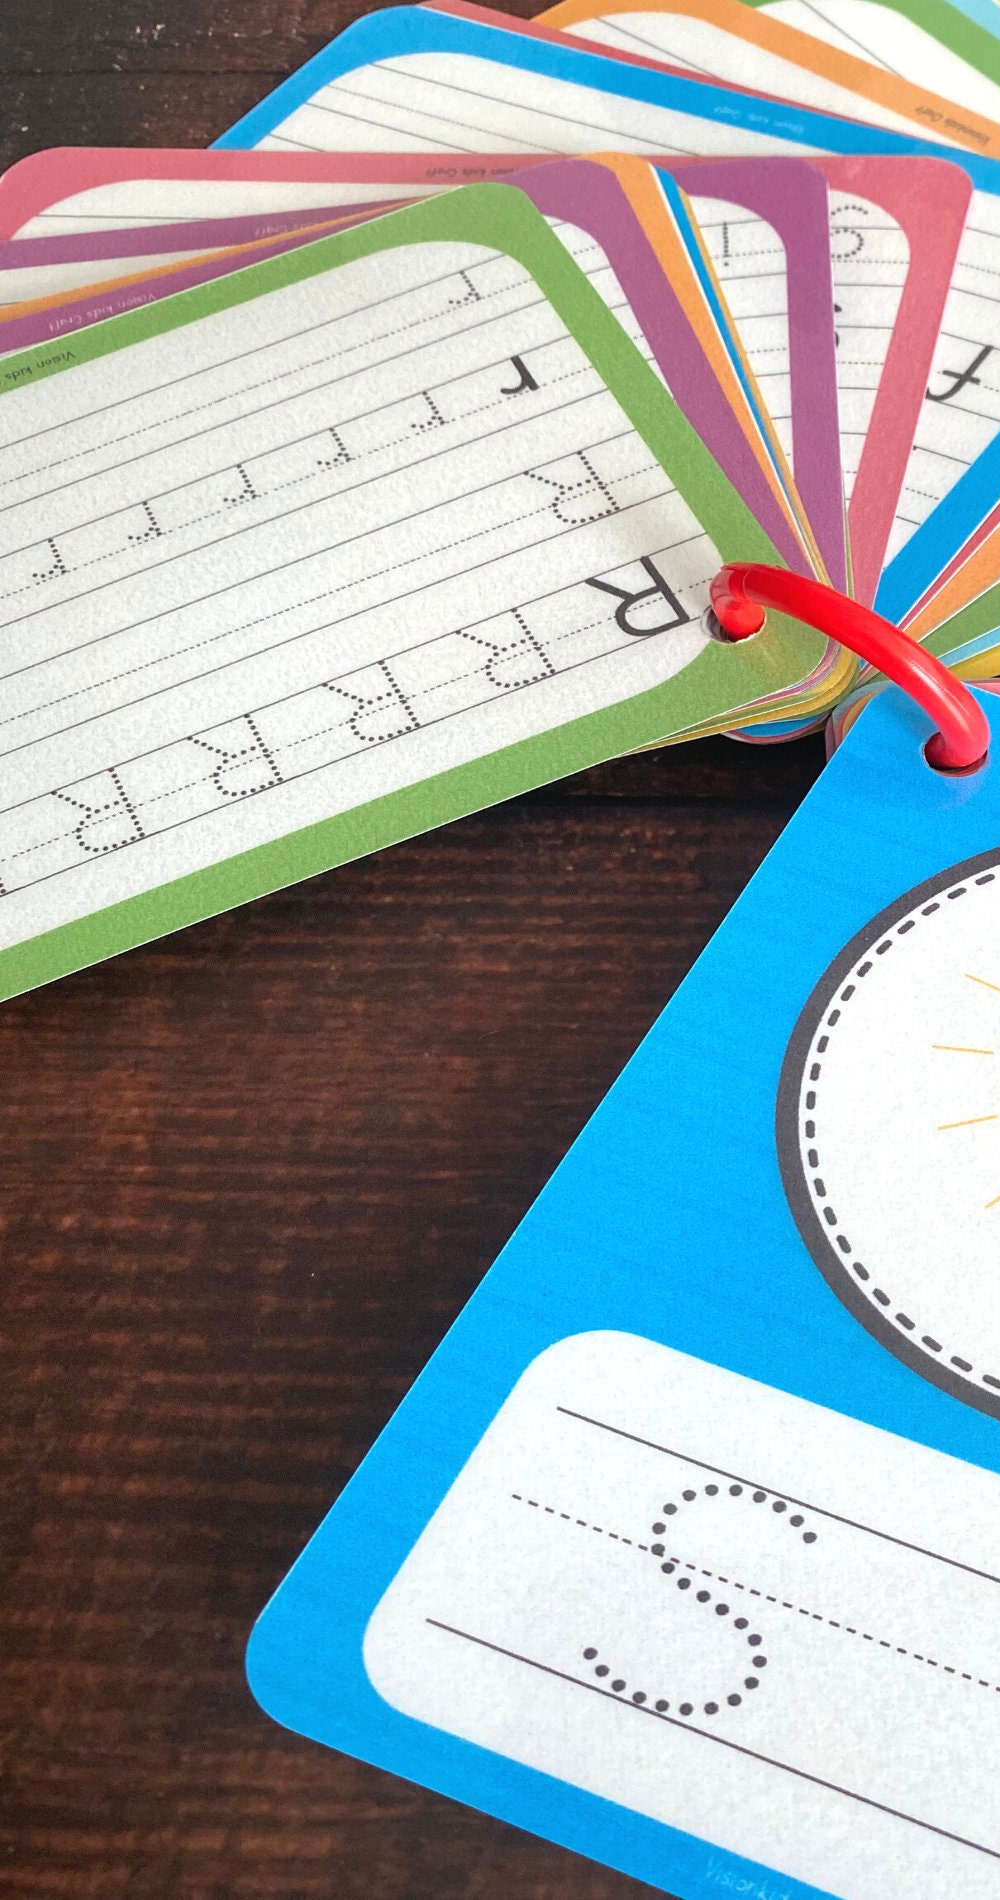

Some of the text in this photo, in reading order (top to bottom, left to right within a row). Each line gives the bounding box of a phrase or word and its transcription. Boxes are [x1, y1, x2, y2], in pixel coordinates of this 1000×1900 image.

[49, 293, 157, 332] Vision kids Craft
[448, 269, 481, 304] r
[4, 350, 77, 382] Vision kids
[32, 355, 539, 578] r r r r r r
[523, 450, 621, 525] R
[50, 556, 690, 853] R R R R R
[583, 1483, 818, 1716] S
